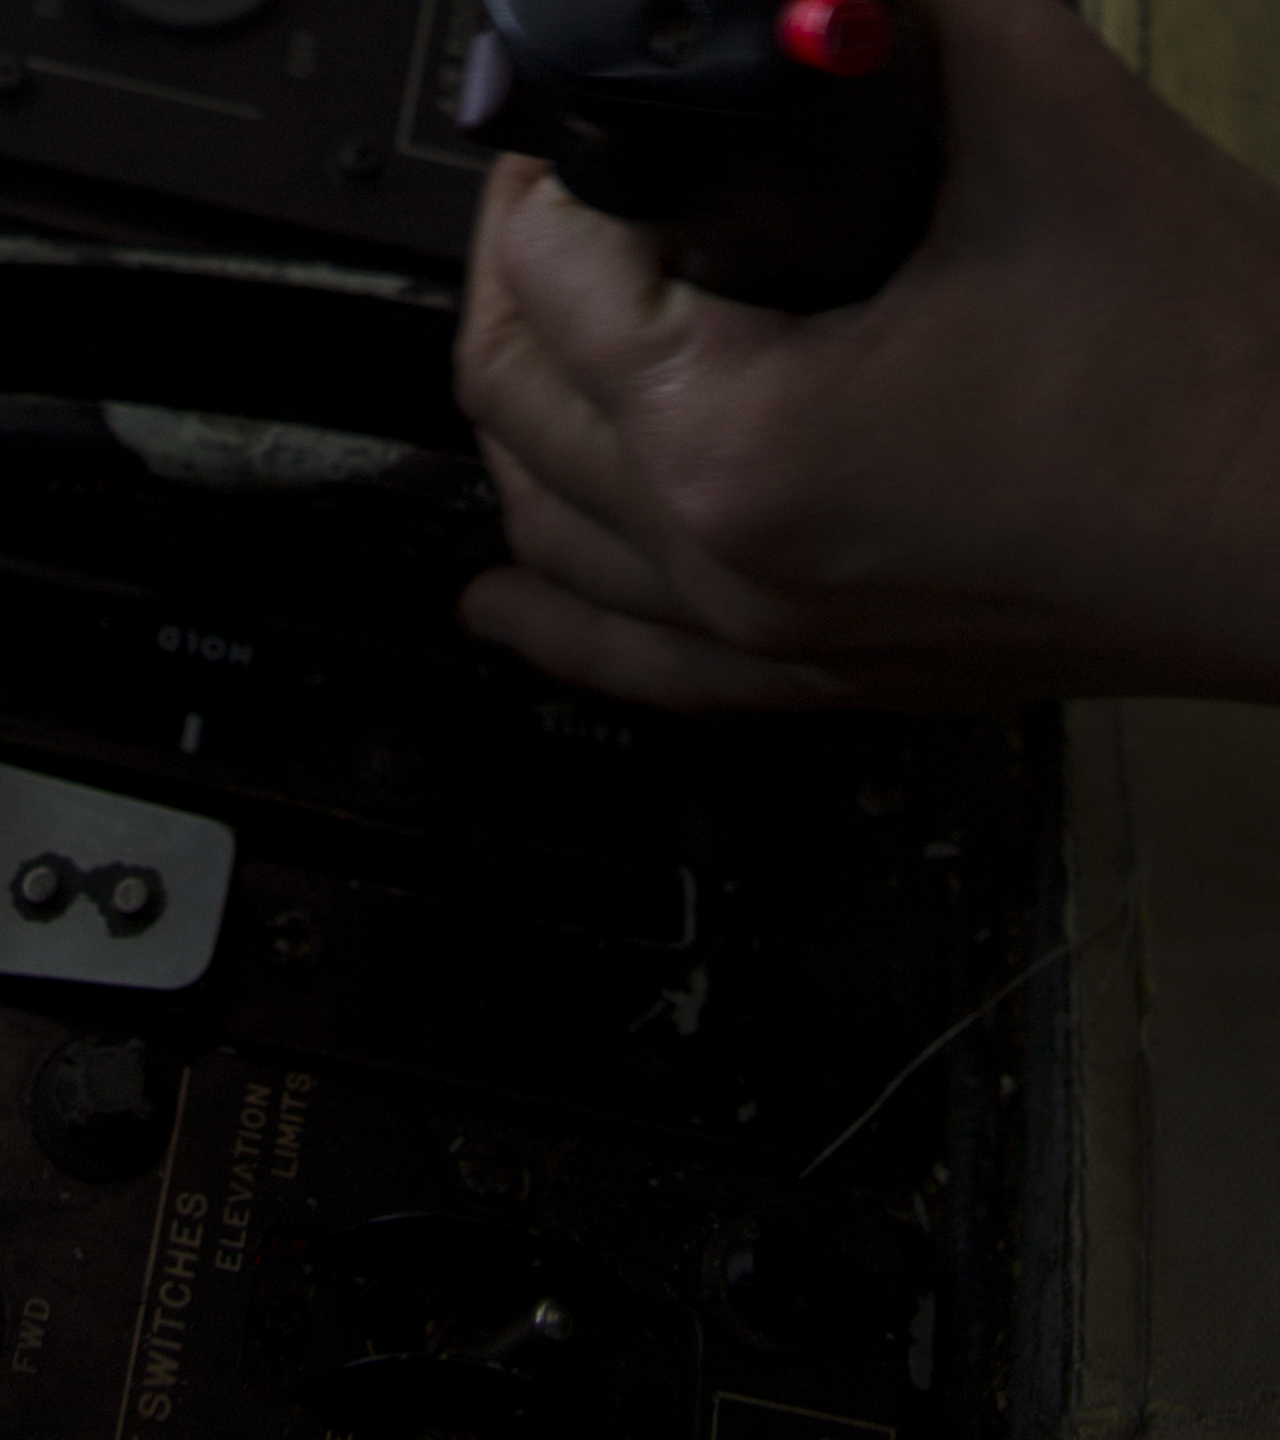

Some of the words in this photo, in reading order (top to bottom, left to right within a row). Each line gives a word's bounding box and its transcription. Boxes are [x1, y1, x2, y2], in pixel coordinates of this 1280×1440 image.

[156, 622, 256, 670] HOLD
[214, 1080, 272, 1274] ELEVATION
[270, 1069, 316, 1181] LIMITS
[11, 1295, 52, 1376] FWD
[137, 1189, 210, 1424] SWITCHES
